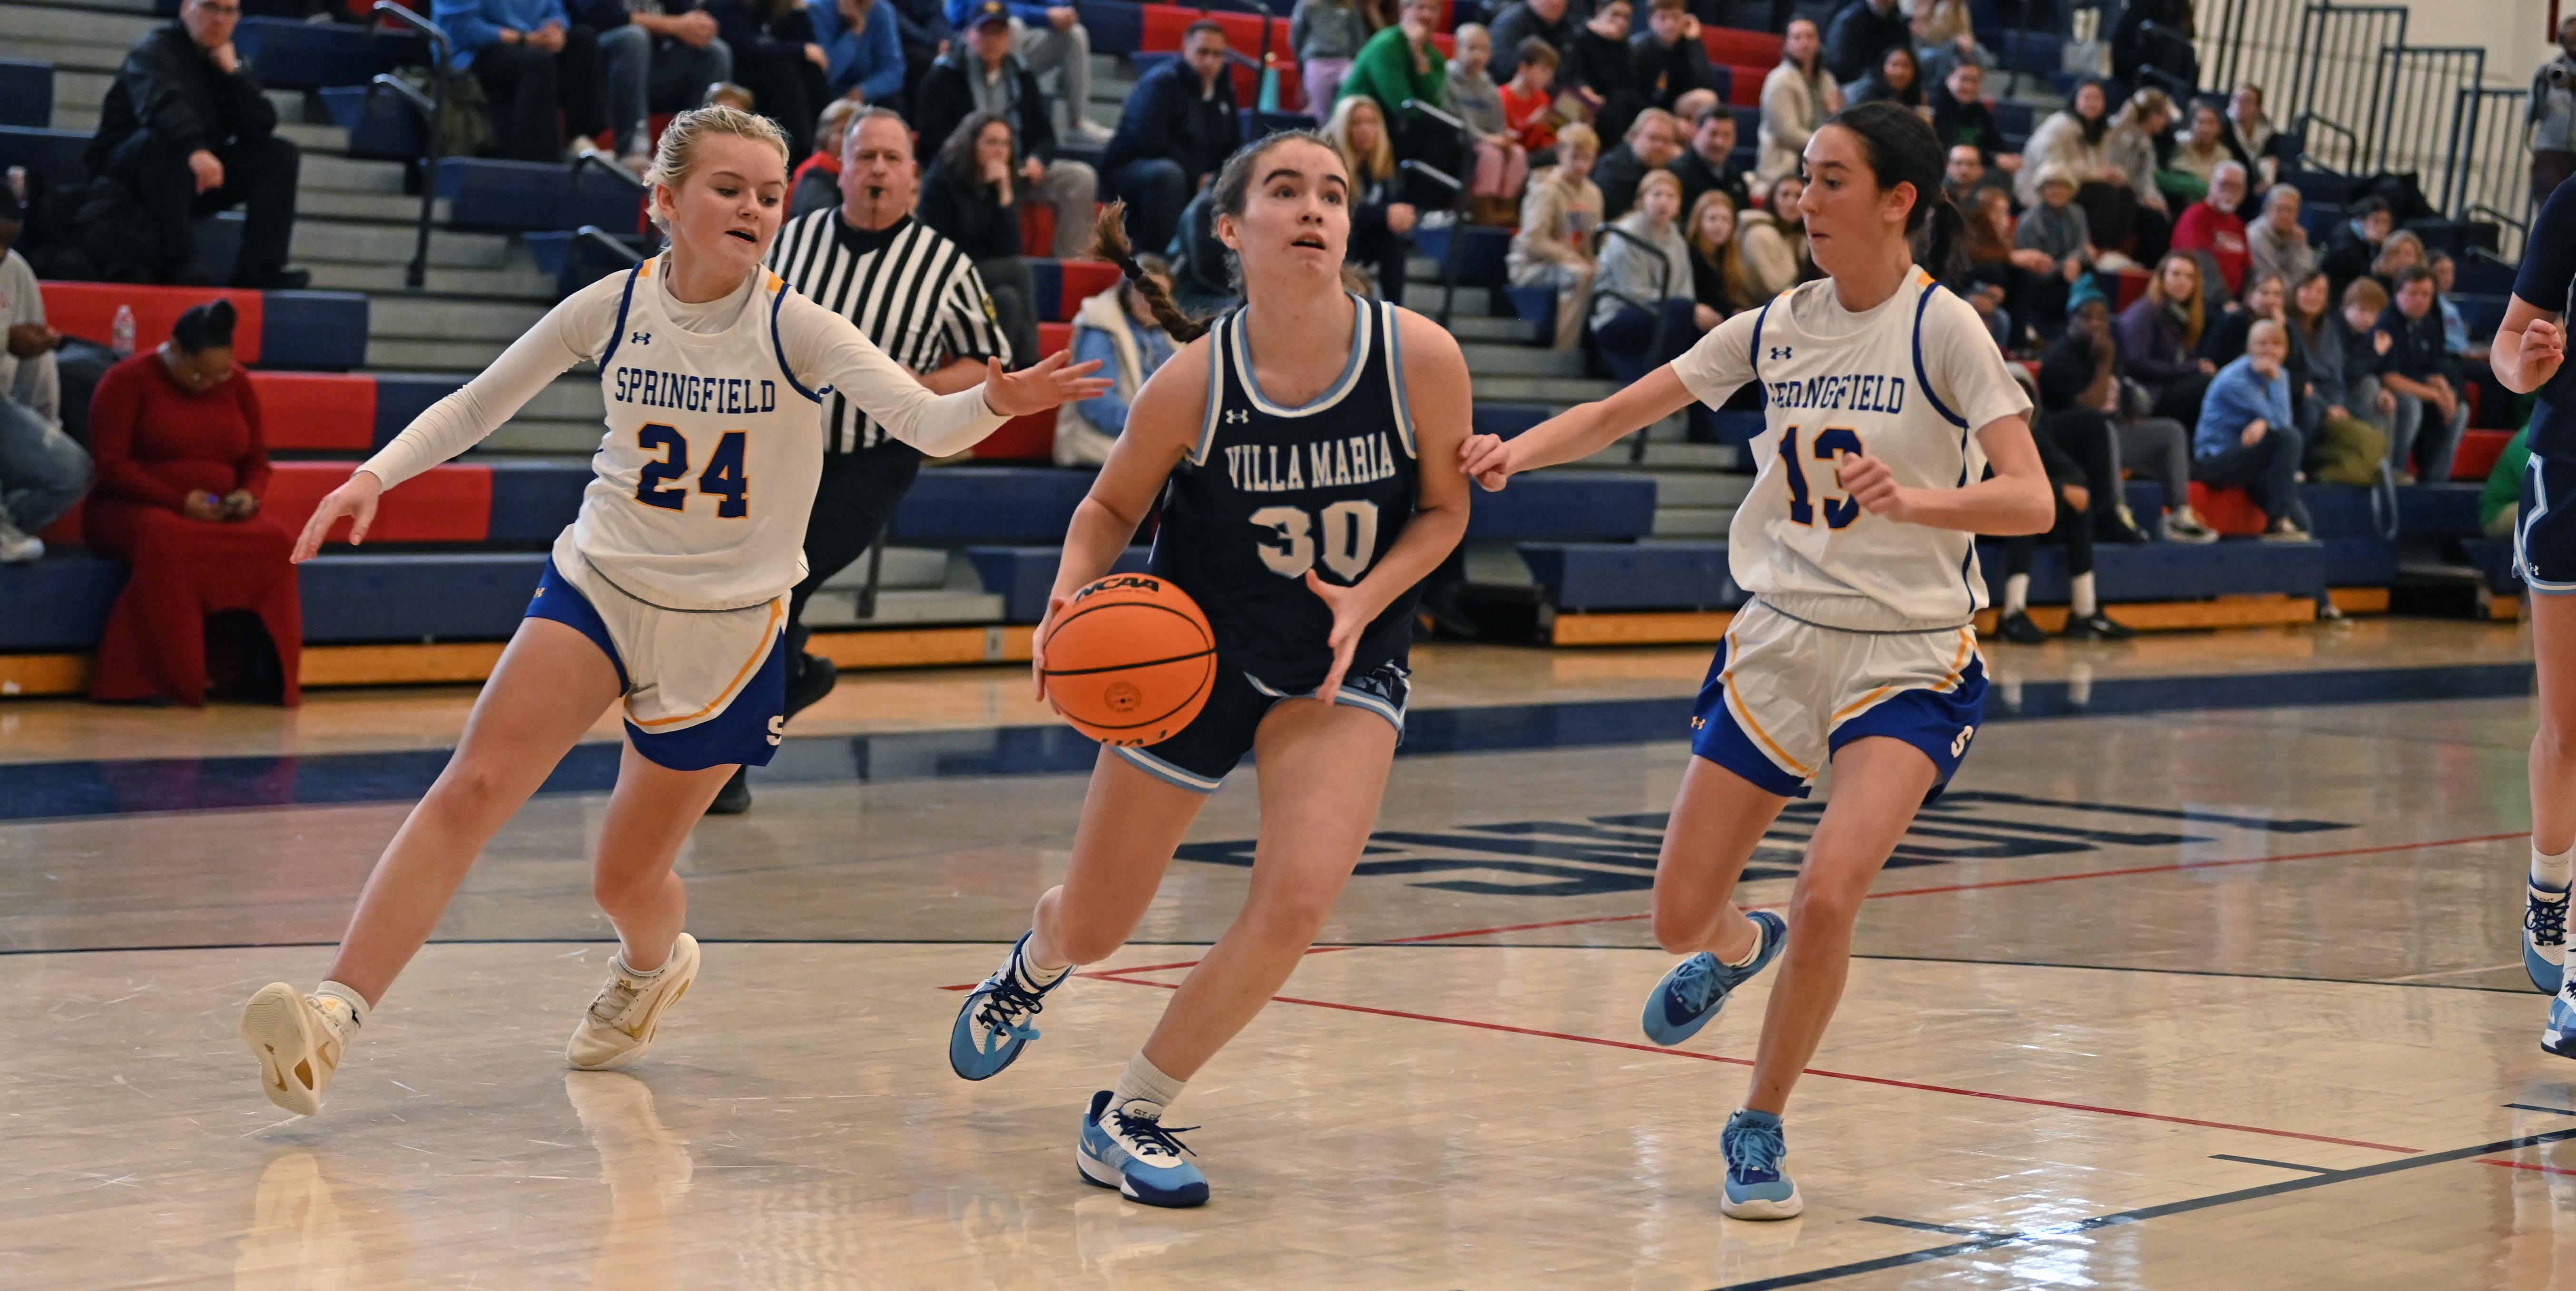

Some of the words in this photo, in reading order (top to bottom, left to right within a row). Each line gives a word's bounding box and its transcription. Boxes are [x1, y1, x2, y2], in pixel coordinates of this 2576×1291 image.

[615, 366, 776, 414] SPRINGFIELD
[633, 421, 749, 520] 24
[1225, 444, 1305, 492] VILLA
[1310, 431, 1396, 488] MARIA
[1779, 424, 1864, 530] 13
[1249, 499, 1379, 582] 30
[1073, 578, 1159, 602] NCAA
[766, 715, 784, 746] S
[1951, 725, 1974, 759] S
